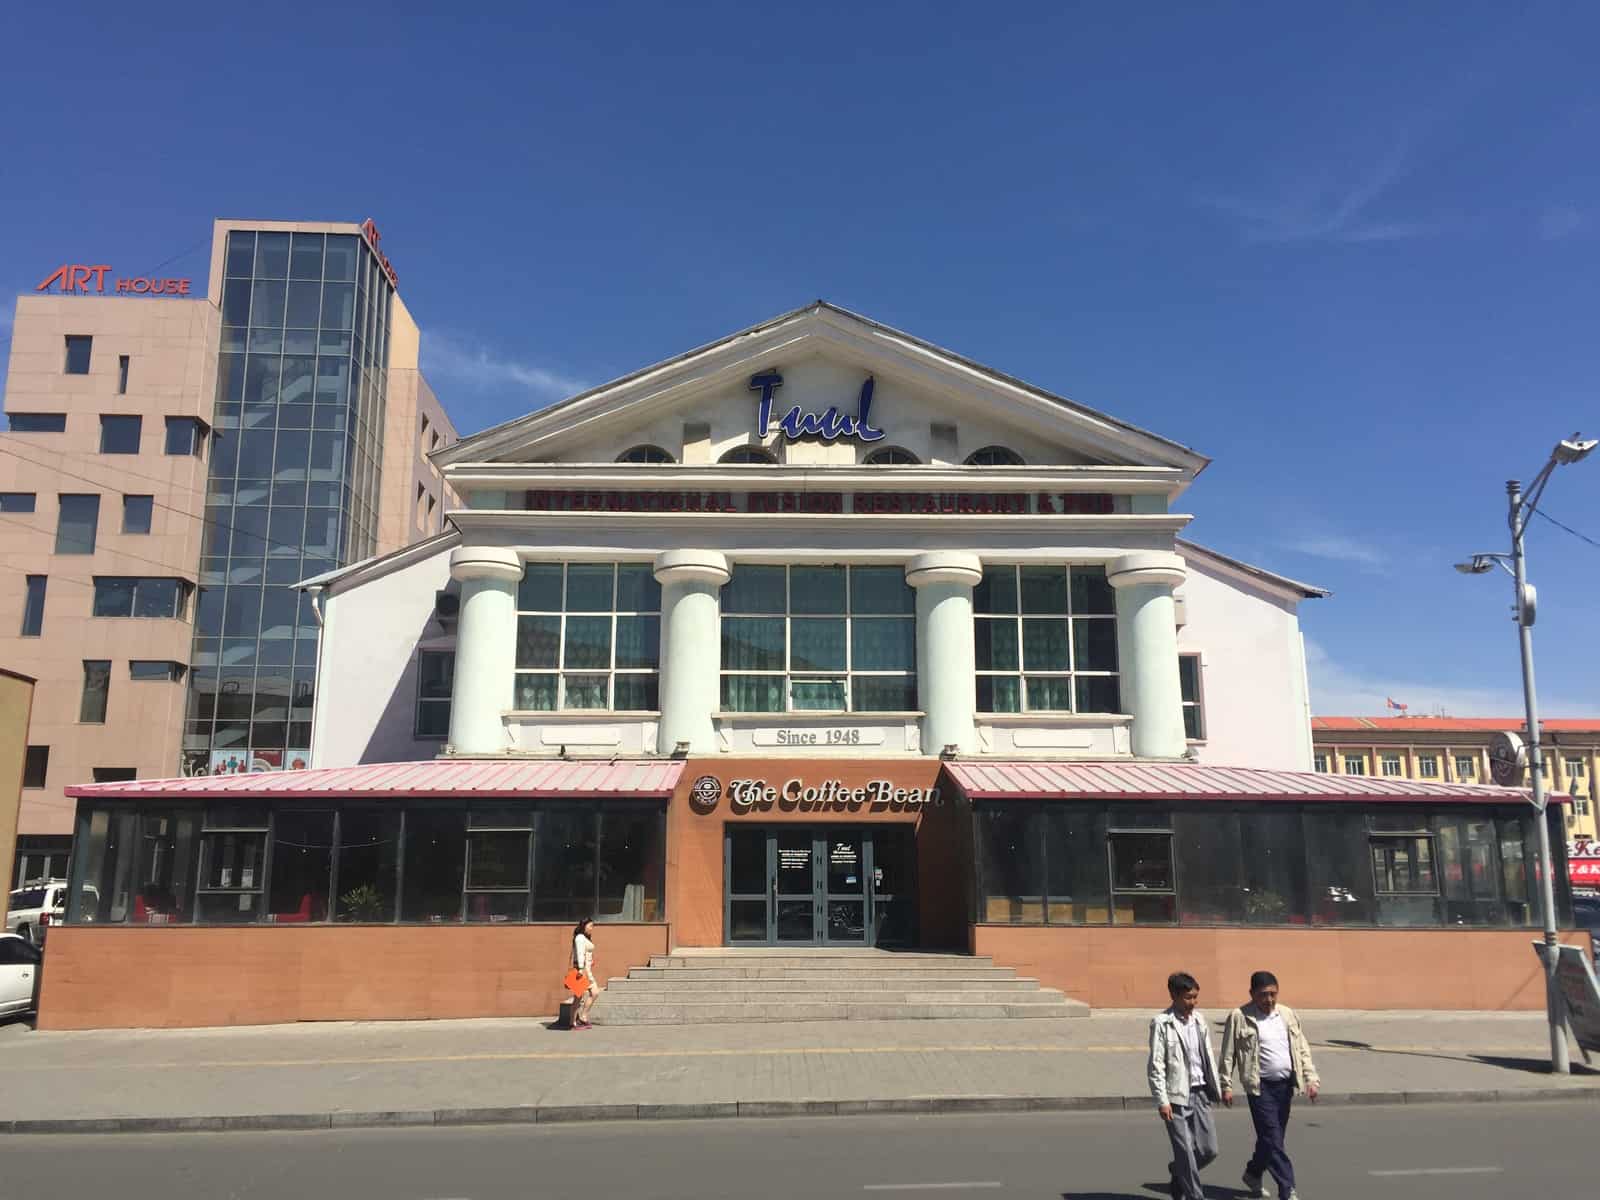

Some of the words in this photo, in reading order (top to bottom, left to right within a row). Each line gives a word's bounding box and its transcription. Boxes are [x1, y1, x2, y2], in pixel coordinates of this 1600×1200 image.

[35, 263, 112, 292] ART
[115, 277, 192, 294] HOUSE
[748, 372, 887, 442] Tuul
[776, 729, 817, 745] Since
[824, 729, 860, 745] 1948
[729, 778, 777, 805] The
[782, 778, 866, 804] Coffee
[866, 778, 941, 804] Bean
